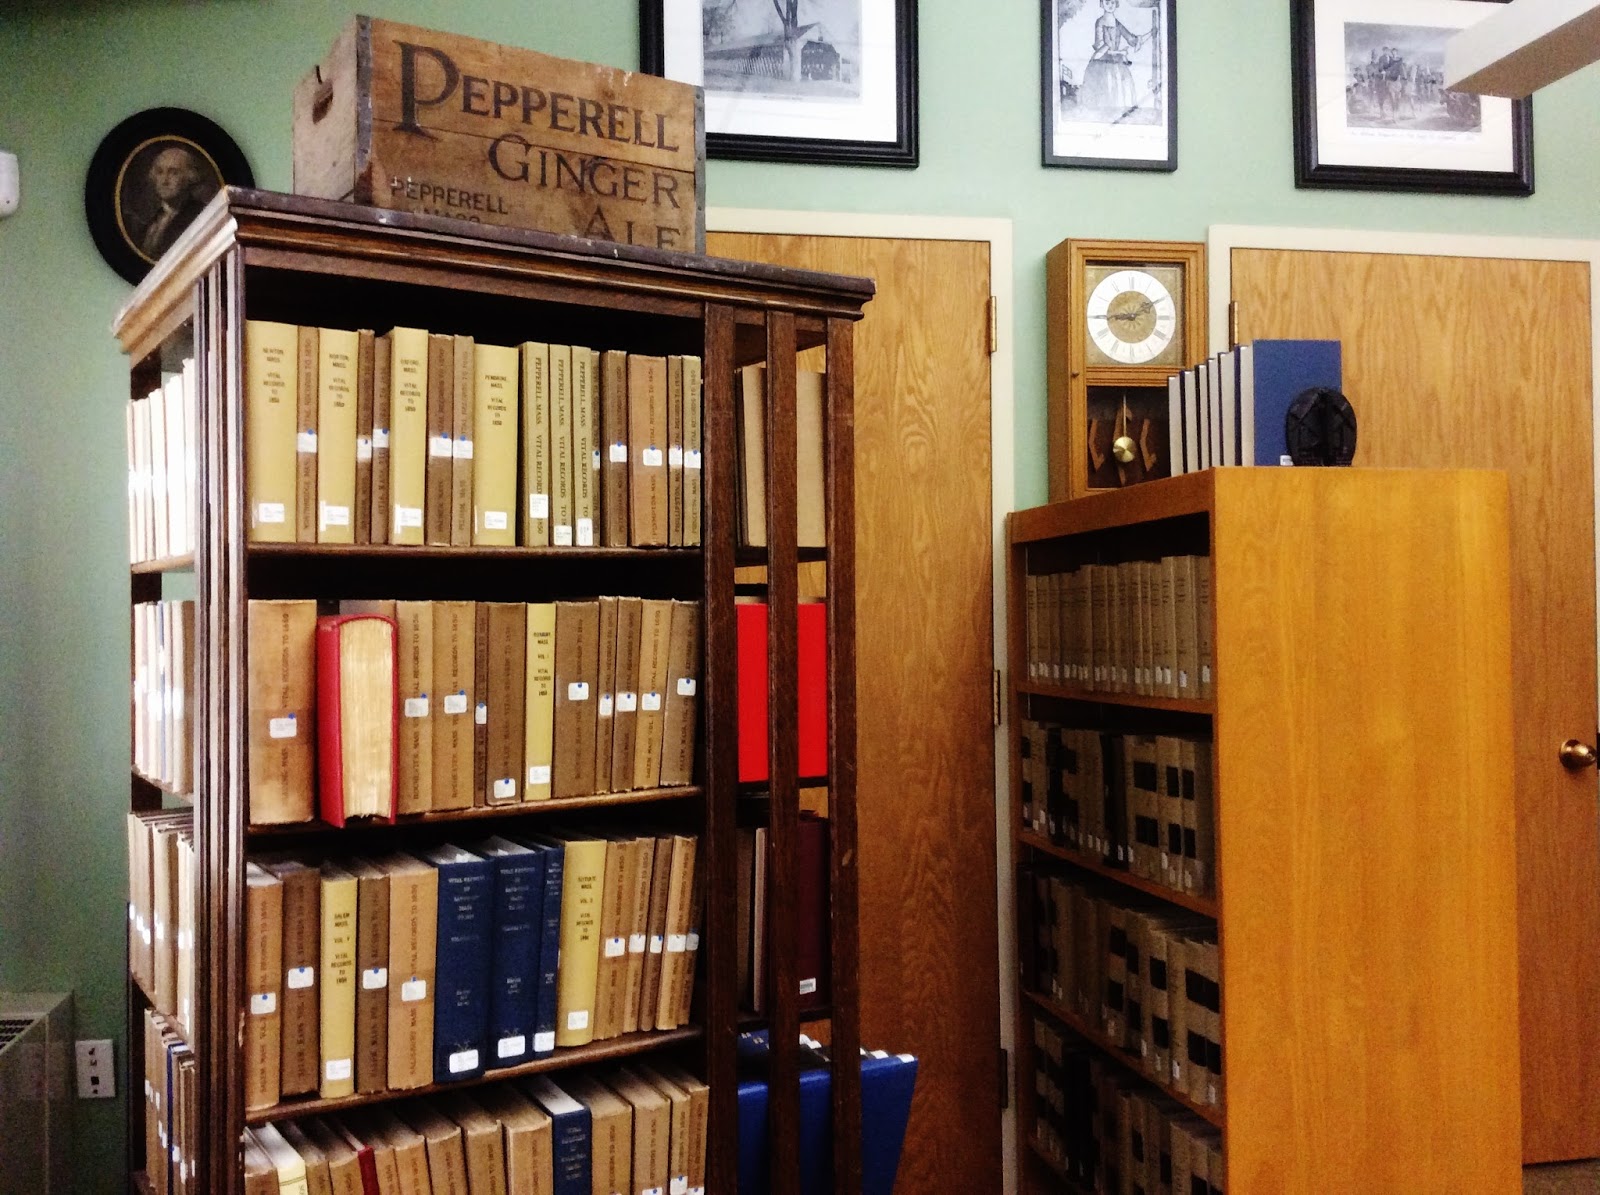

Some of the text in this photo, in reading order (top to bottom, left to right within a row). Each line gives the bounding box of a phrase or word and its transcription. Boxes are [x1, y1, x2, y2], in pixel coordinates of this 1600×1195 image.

[392, 39, 680, 152] PEPPERELL
[488, 133, 681, 209] GINGER
[390, 177, 509, 215] PEPPERELL
[559, 462, 567, 498] RECORDS
[560, 505, 567, 517] TO
